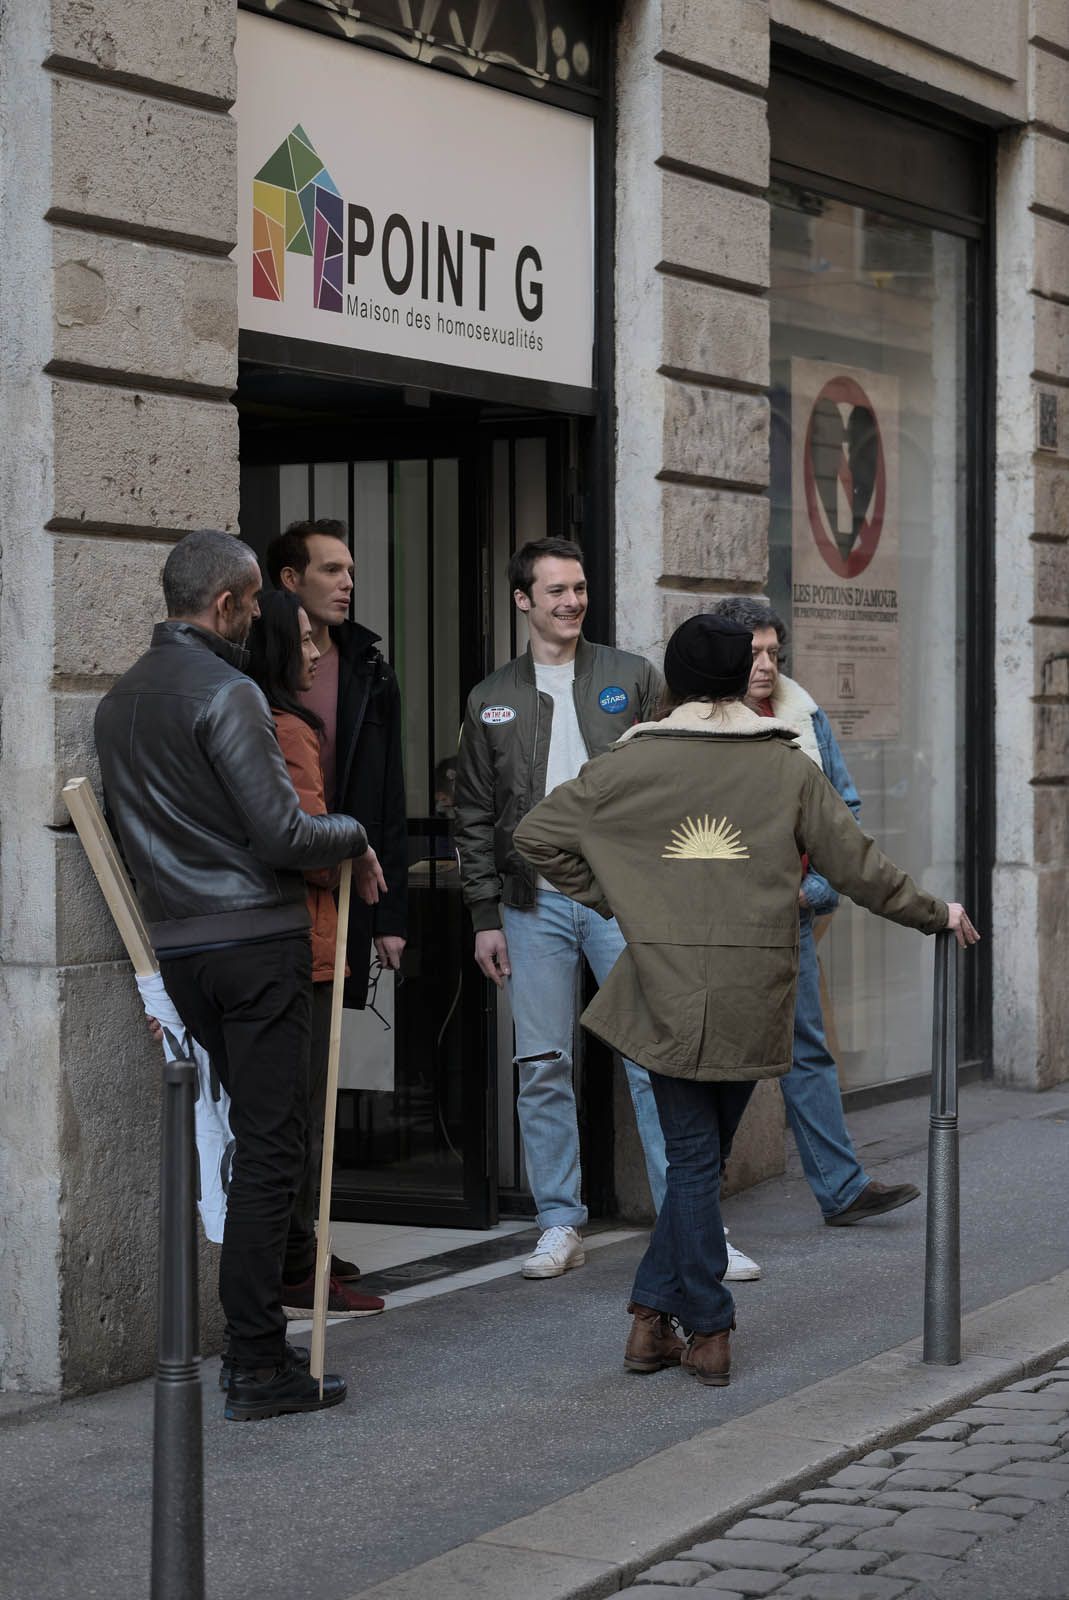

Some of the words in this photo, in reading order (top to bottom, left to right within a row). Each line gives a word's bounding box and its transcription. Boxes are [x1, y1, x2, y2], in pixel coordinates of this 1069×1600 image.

[348, 203, 495, 311] POINT
[515, 245, 543, 322] G
[347, 294, 399, 325] Maison
[406, 307, 431, 330] des
[437, 312, 543, 351] homosexualités
[793, 584, 810, 602] LES
[812, 585, 853, 606] POTIONS
[855, 588, 898, 608] D'AMOUR
[601, 694, 625, 706] STARS
